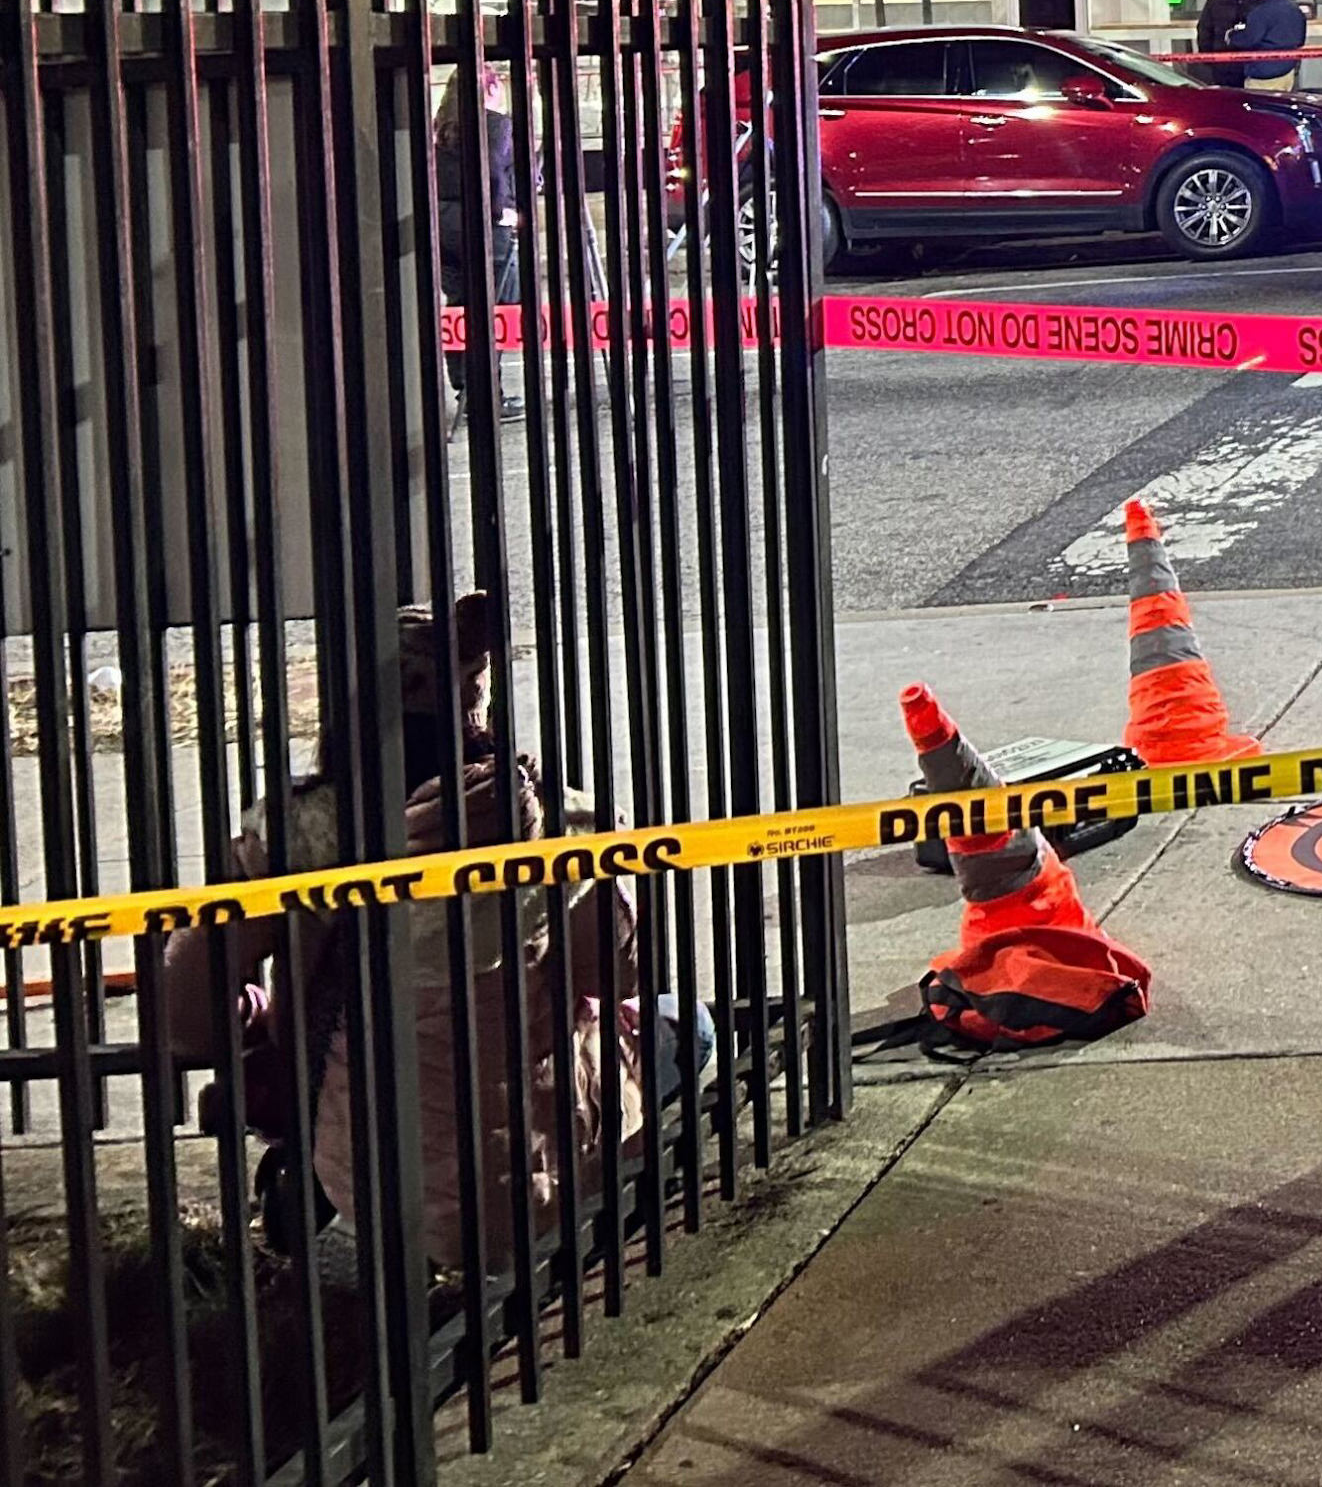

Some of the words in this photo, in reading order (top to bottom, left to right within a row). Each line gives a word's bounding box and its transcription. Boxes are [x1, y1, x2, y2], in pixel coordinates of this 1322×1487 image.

[850, 305, 935, 342] CROSS
[942, 310, 996, 347] NOT
[1001, 313, 1038, 349] DO
[1045, 316, 1139, 356] SCENE
[1148, 316, 1238, 359] CRIME
[879, 784, 1109, 846] POLICE
[1135, 765, 1271, 816] LINE
[766, 834, 834, 855] SIRCHIE
[279, 871, 427, 915] NOT
[450, 837, 684, 893] CROSS
